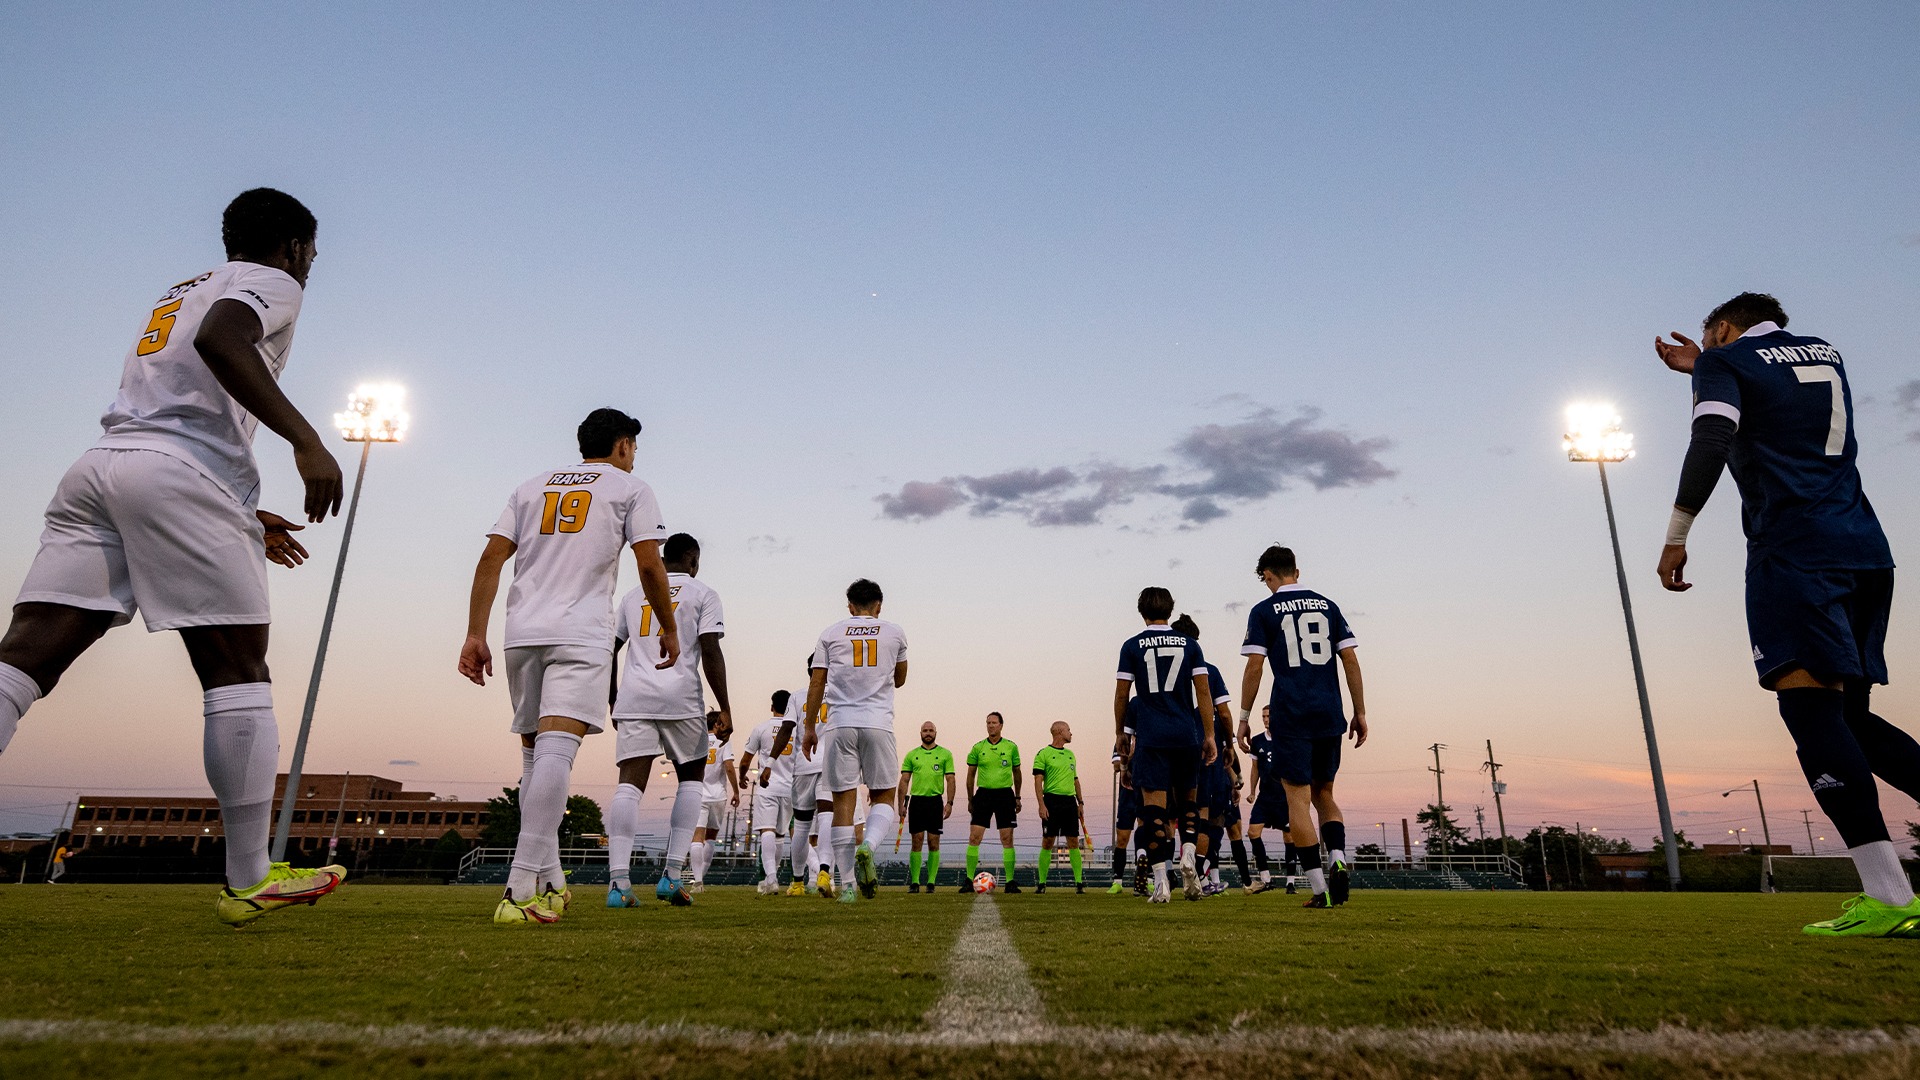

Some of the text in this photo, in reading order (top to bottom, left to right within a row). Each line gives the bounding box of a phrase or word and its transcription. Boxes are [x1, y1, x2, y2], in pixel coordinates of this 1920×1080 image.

[136, 297, 184, 357] 5
[1755, 343, 1841, 365] PANTHERS
[1791, 365, 1847, 456] 7
[547, 473, 602, 486] RAMS
[540, 490, 593, 535] 19
[1273, 598, 1329, 614] PANTHERS
[846, 626, 880, 636] RAMS
[1138, 635, 1187, 649] PANTHERS
[1281, 612, 1333, 668] 18
[850, 639, 878, 667] 11
[1143, 647, 1185, 693] 17
